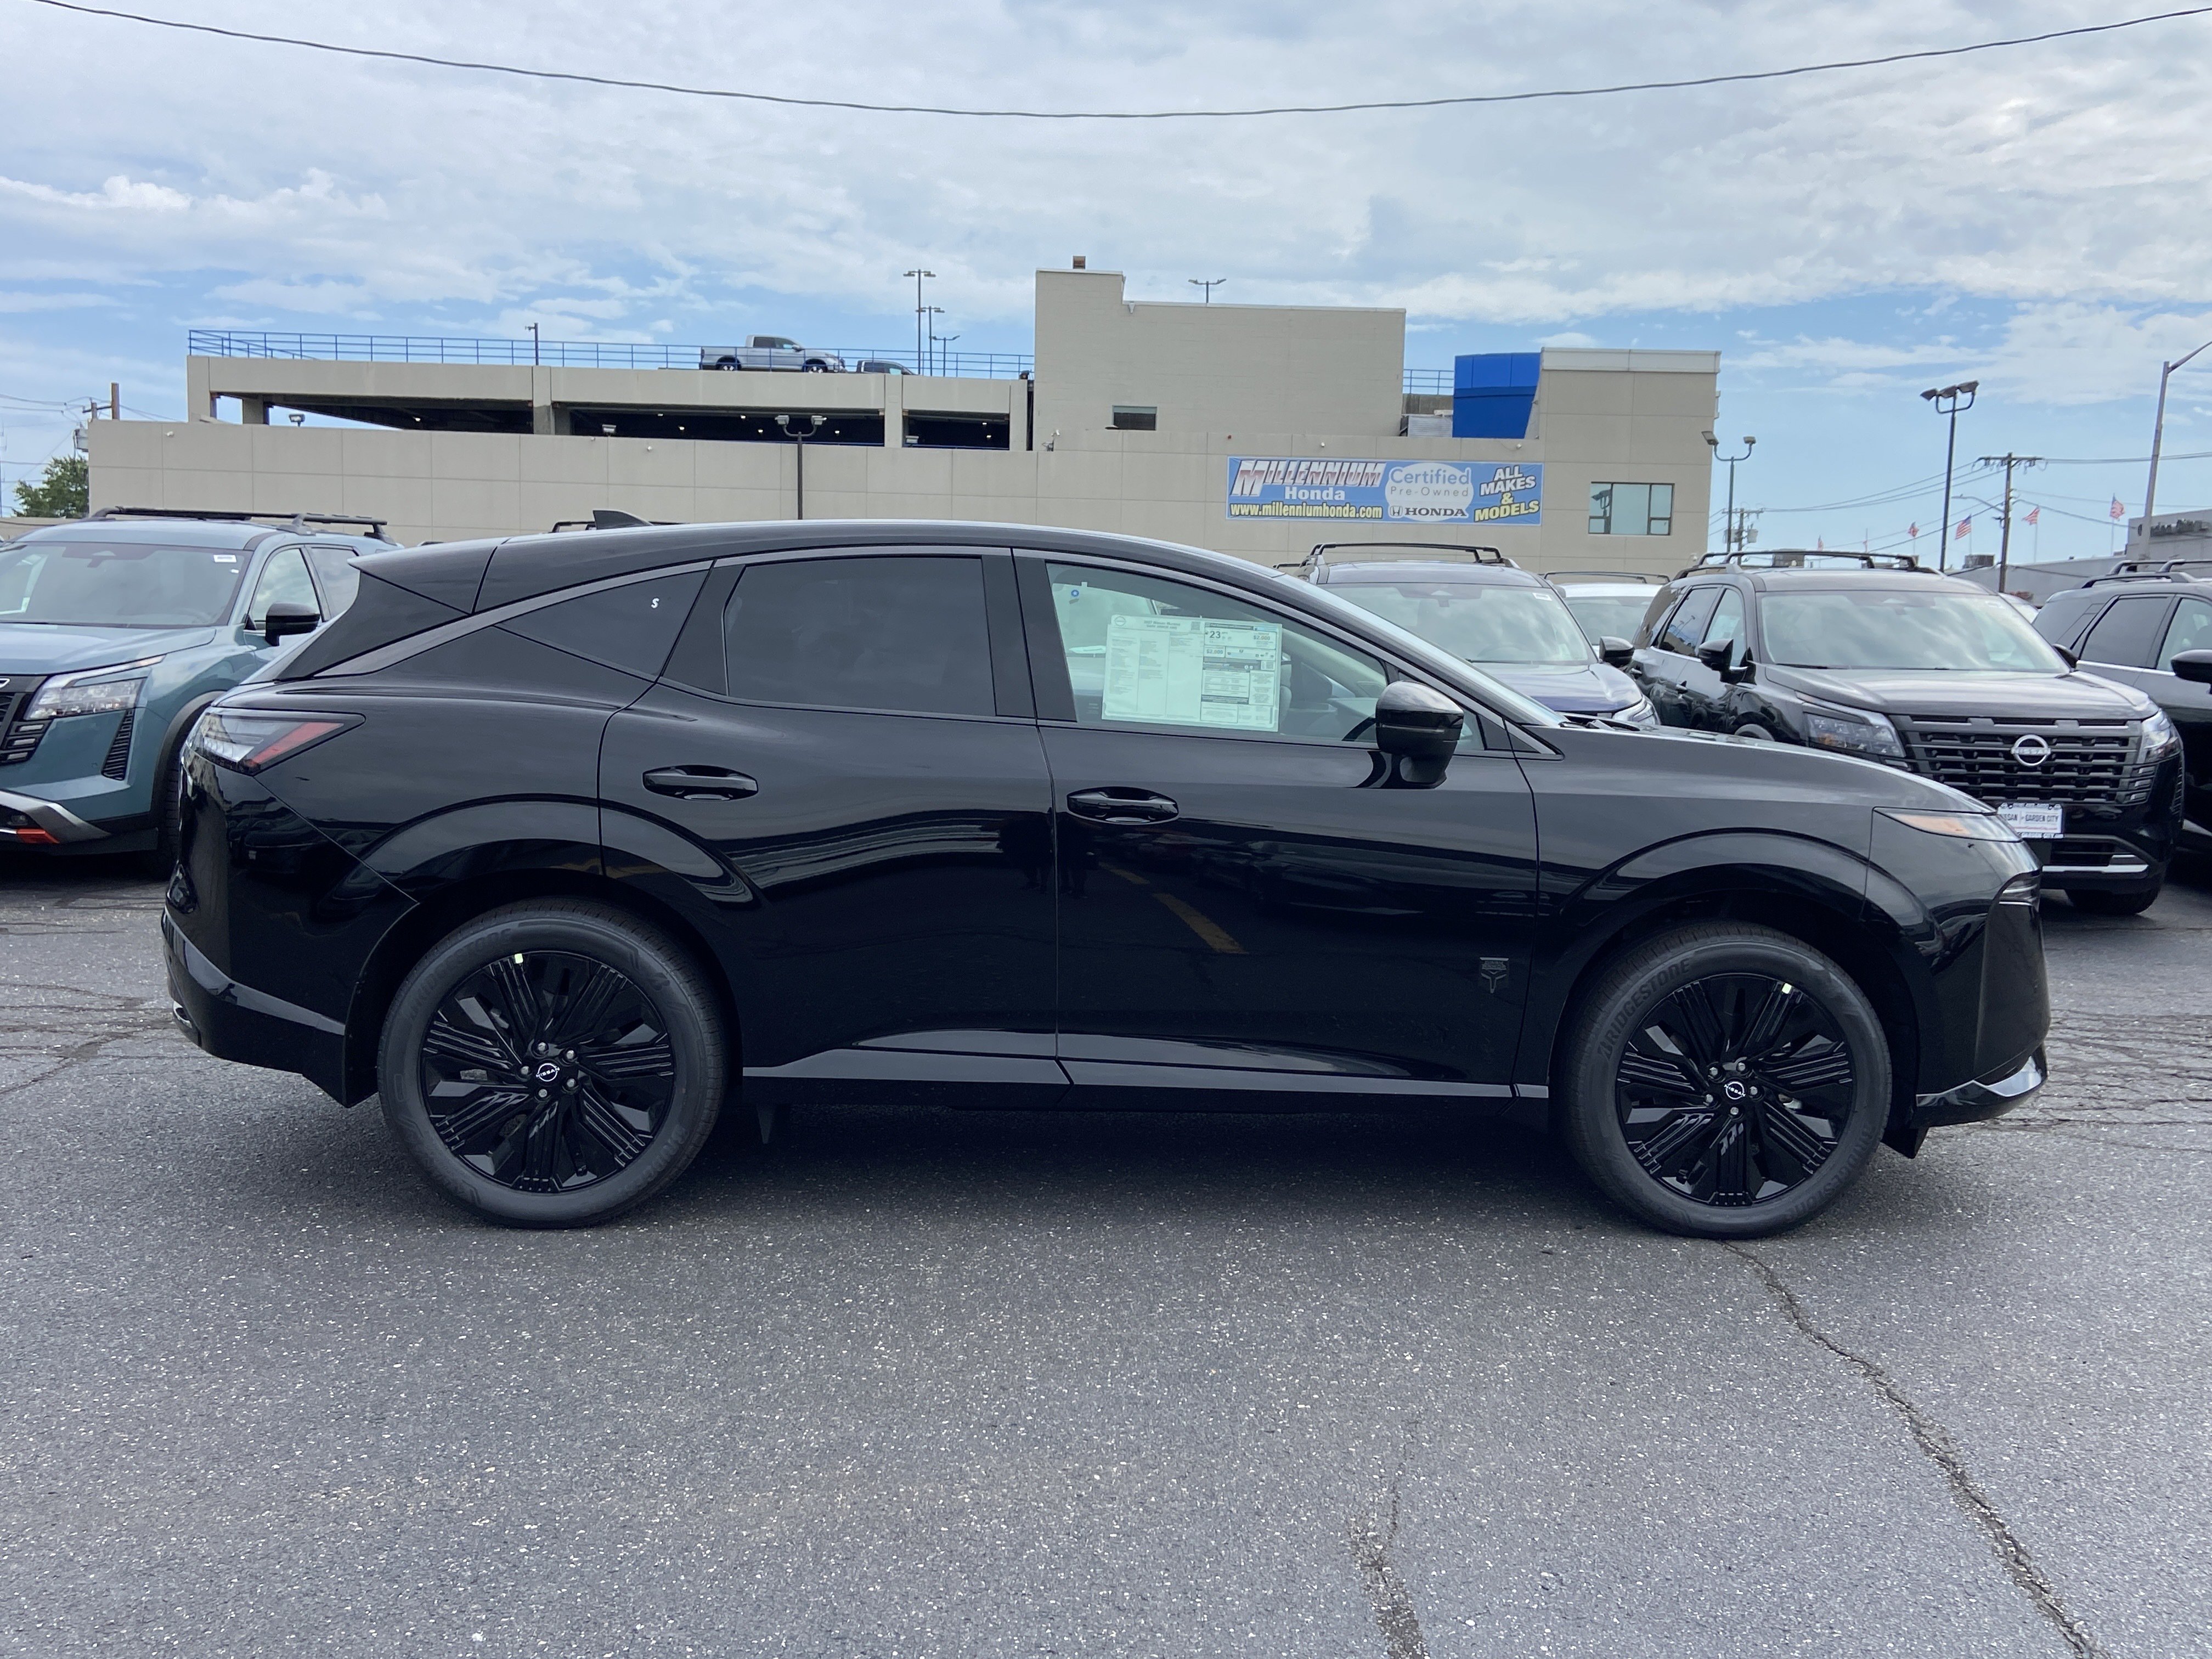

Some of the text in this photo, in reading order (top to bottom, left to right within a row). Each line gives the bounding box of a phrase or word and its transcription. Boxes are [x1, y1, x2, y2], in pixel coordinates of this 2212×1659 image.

[1230, 460, 1386, 496] MILLENNIUM
[1390, 469, 1469, 485] Certified
[1494, 466, 1522, 481] ALL
[1284, 486, 1345, 501] Honda
[1390, 486, 1469, 496] Pre-Owned
[1480, 476, 1536, 496] MAKES
[1501, 492, 1513, 505] &
[1230, 501, 1383, 519] www.millenniumhonda.com
[1404, 507, 1467, 517] HONDA
[1475, 500, 1539, 522] MODELS
[651, 598, 659, 608] S
[1209, 630, 1221, 639] 23
[1597, 958, 1691, 1061] BRIDGESTONE
